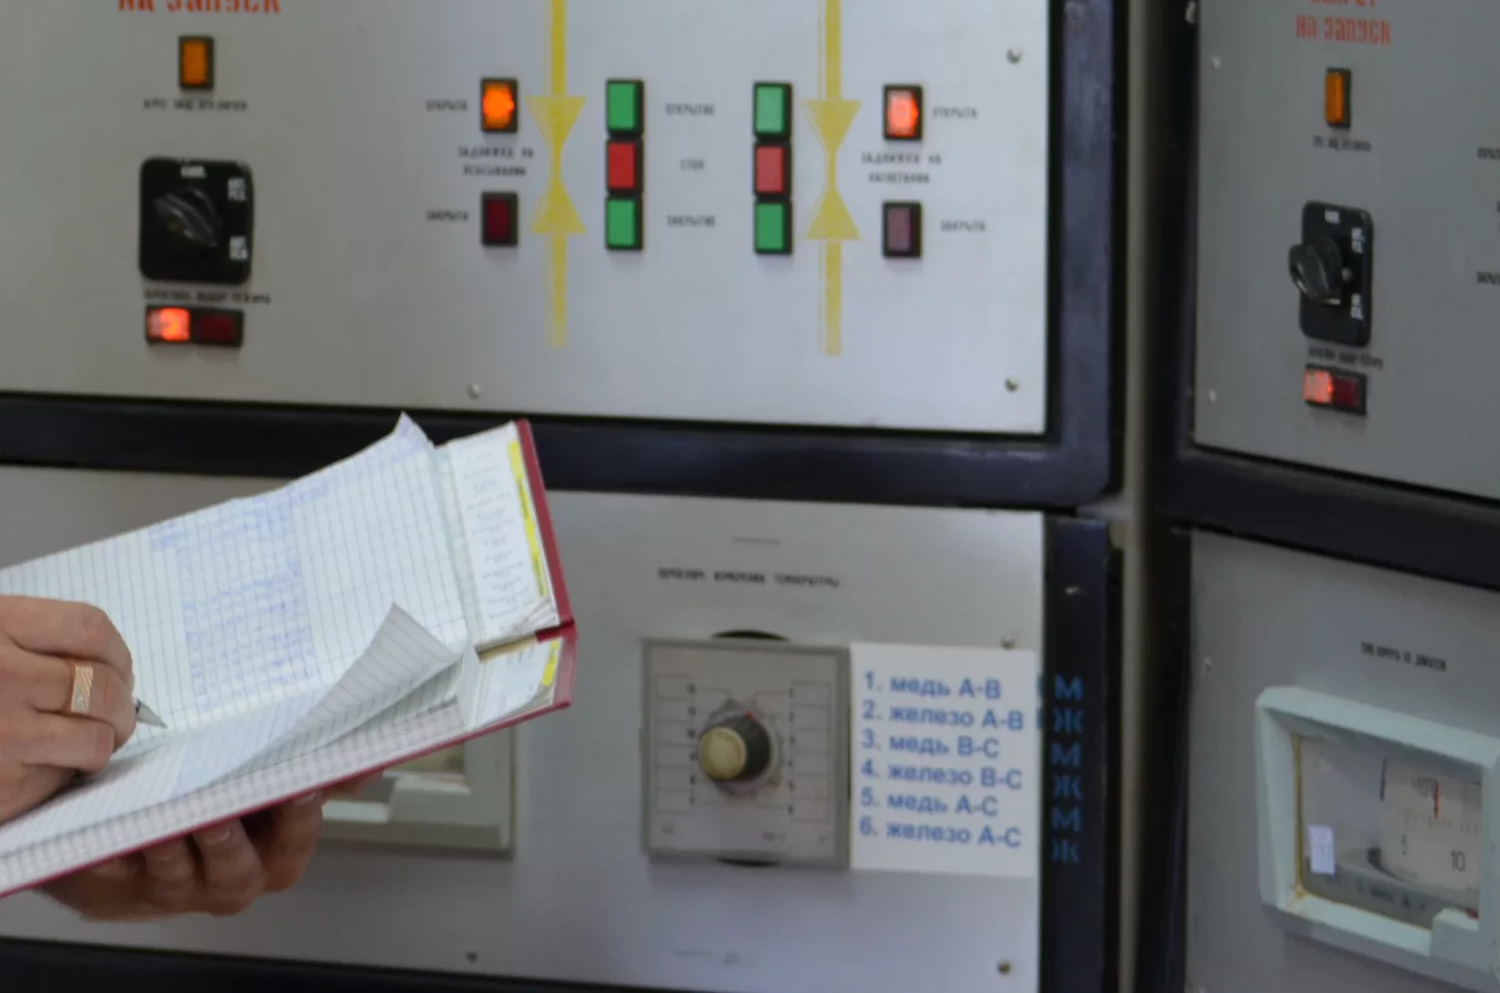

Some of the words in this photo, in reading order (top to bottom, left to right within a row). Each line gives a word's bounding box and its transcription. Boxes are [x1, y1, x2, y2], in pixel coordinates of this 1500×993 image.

[1324, 16, 1391, 46] ЗАПУСК
[889, 676, 951, 697] медь
[1055, 673, 1084, 701] М
[889, 706, 975, 726] железо
[1053, 708, 1084, 734] Ж
[888, 735, 949, 756] медь
[1051, 741, 1082, 768] М
[887, 764, 973, 786] железо
[1052, 773, 1083, 800] Ж
[886, 794, 948, 814] медь
[1052, 807, 1082, 832] М
[886, 822, 971, 844] железо
[1051, 837, 1080, 864] Ж
